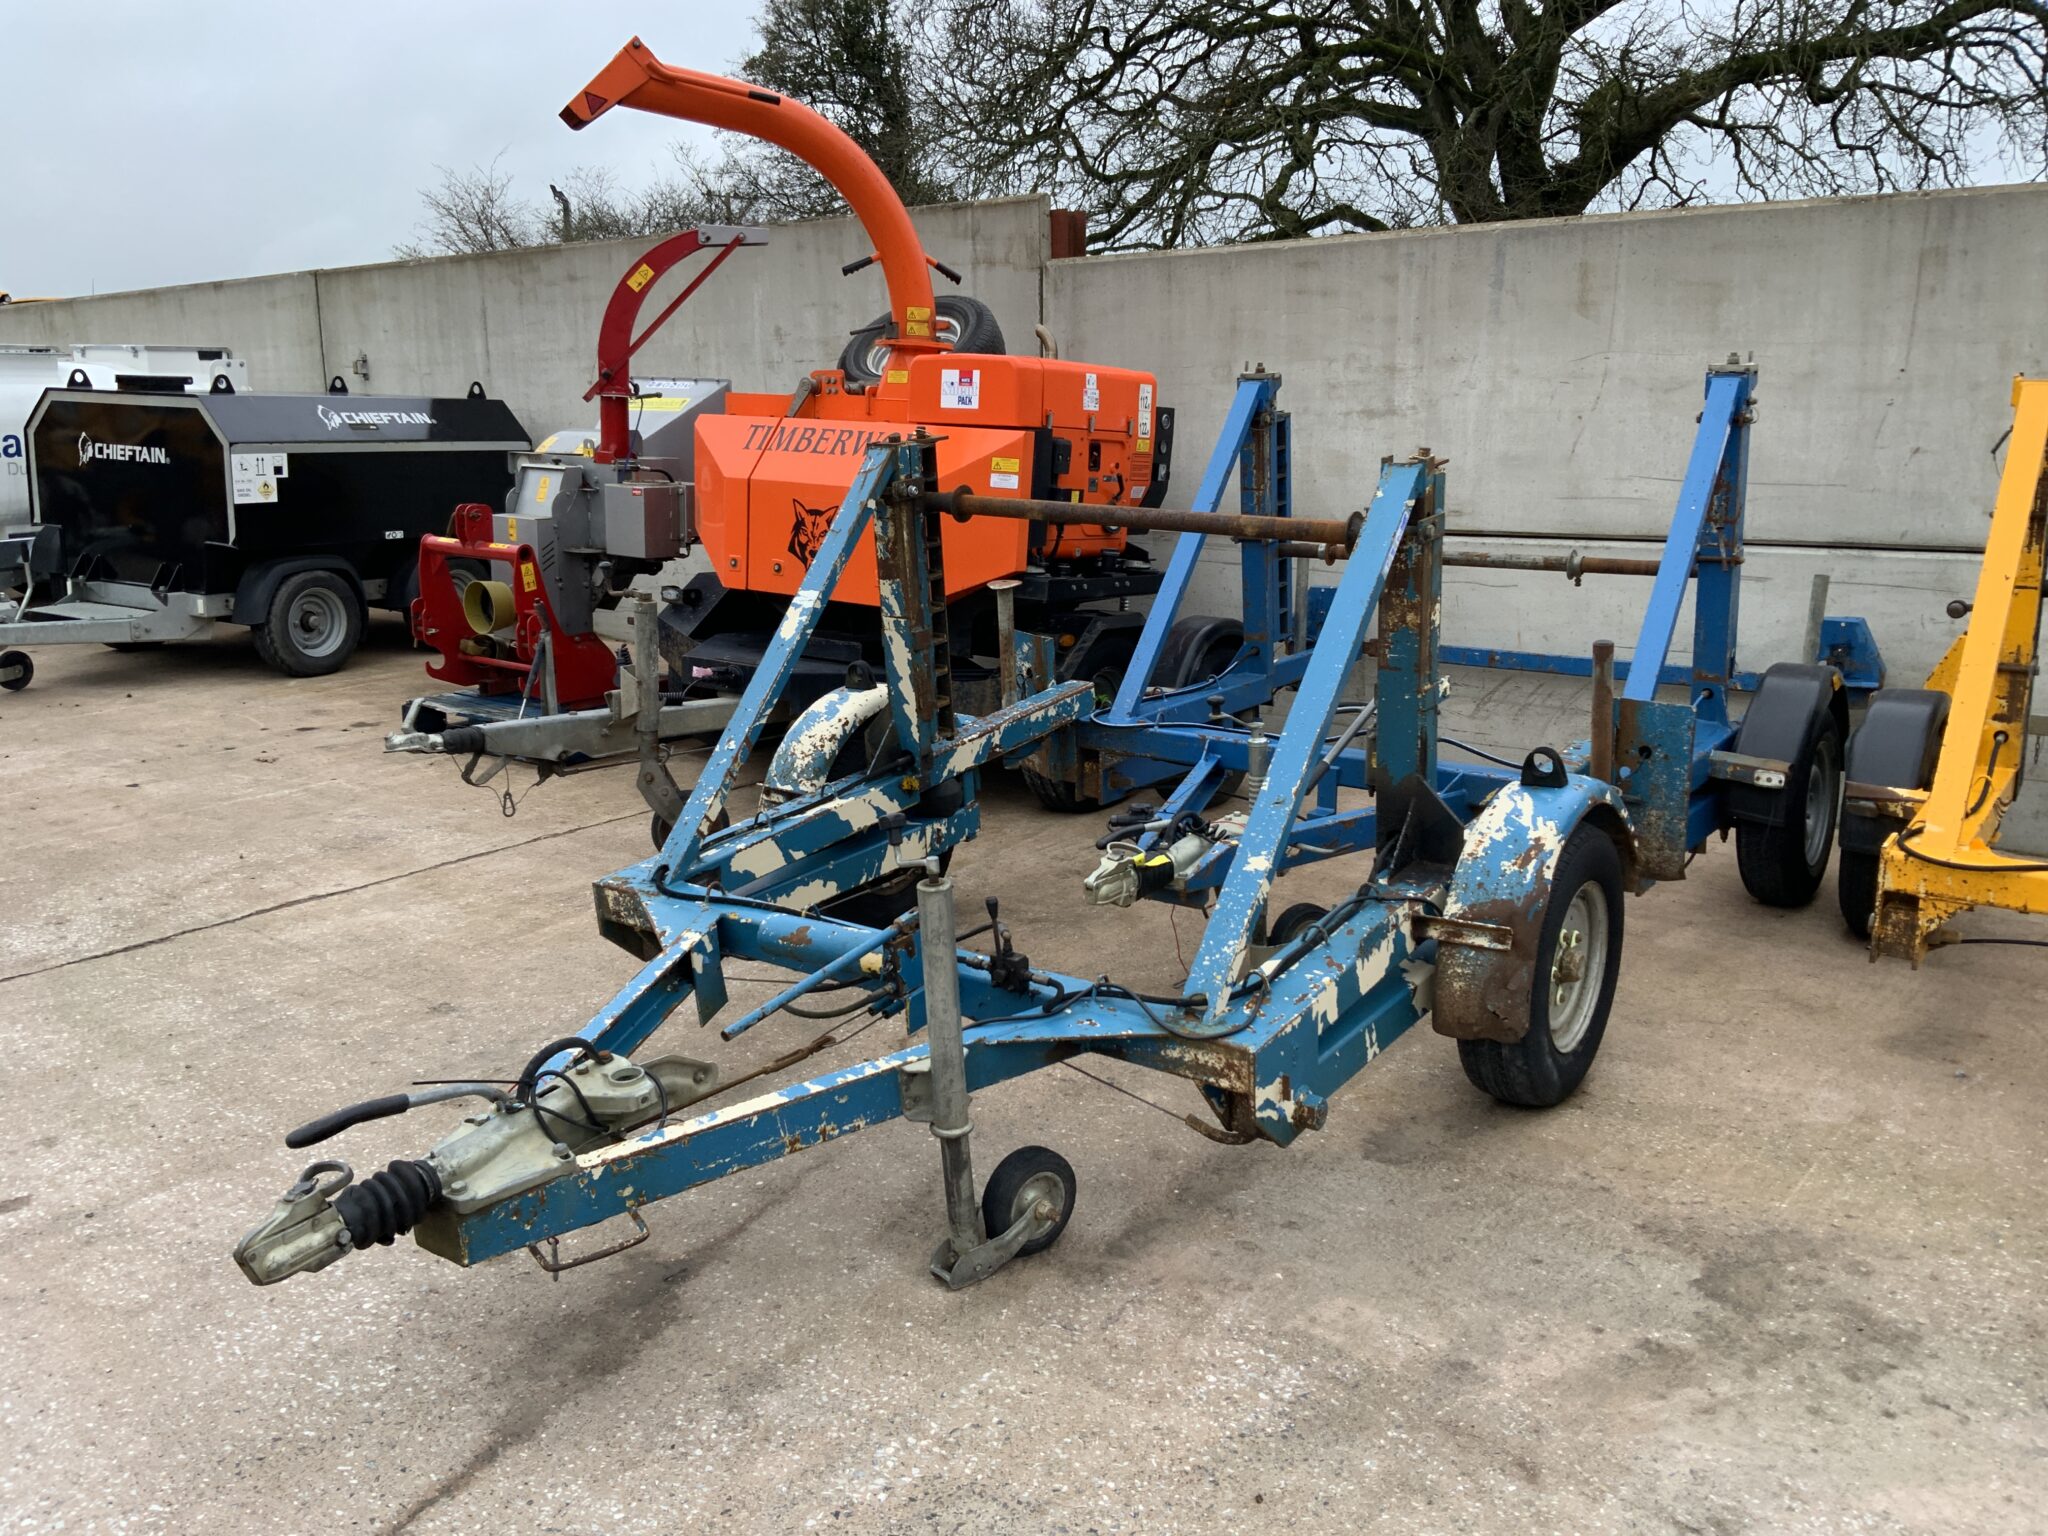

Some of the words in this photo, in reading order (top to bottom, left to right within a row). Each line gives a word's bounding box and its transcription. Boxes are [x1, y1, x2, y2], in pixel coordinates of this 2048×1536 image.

[957, 395, 973, 406] PACK
[340, 412, 432, 424] CHIEFTAIN
[94, 442, 166, 464] CHIEFTAIN
